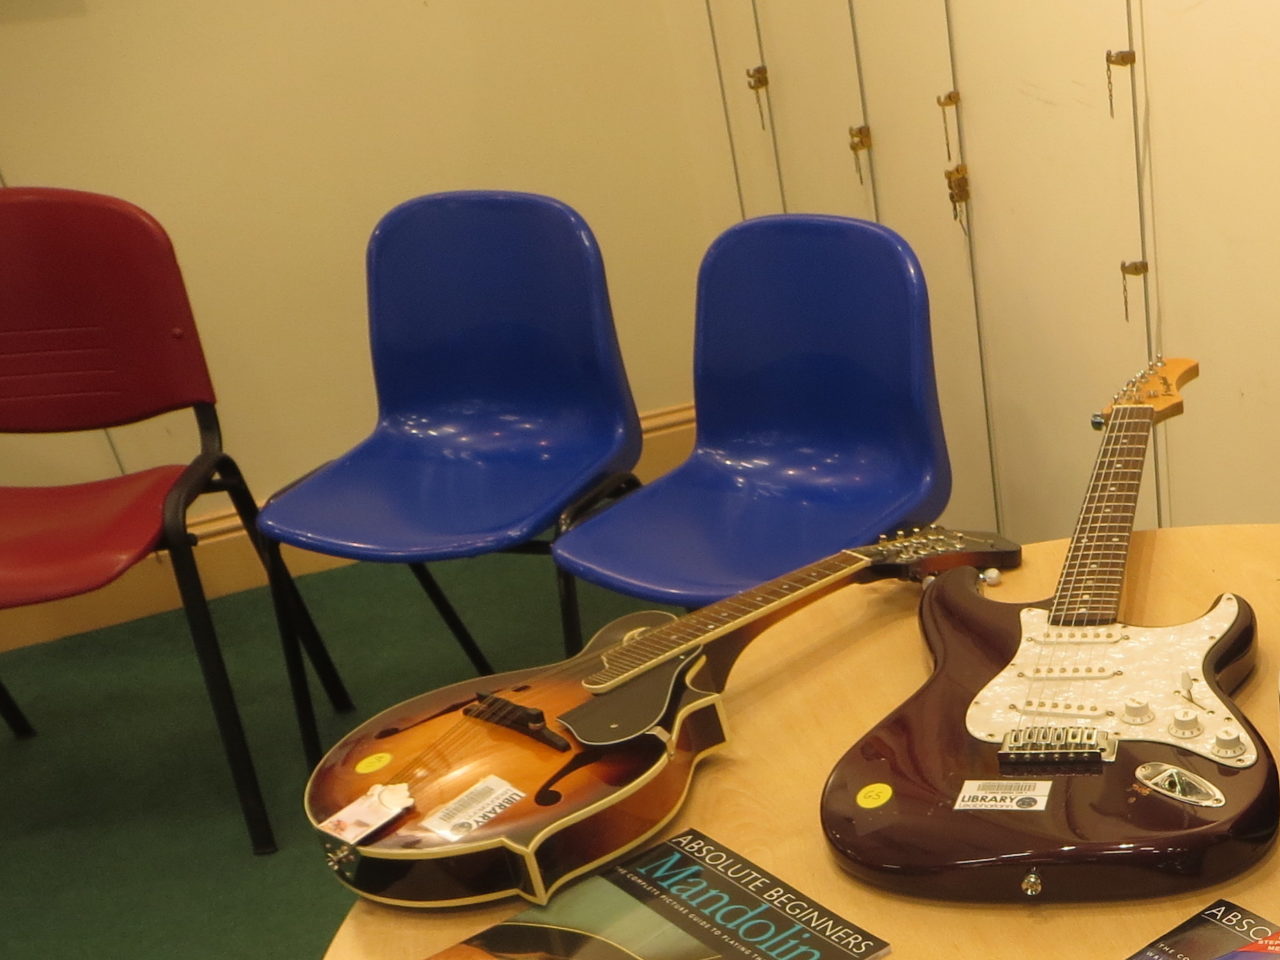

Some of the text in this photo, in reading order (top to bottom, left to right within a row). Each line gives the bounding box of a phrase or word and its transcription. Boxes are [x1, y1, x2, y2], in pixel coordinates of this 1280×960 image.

[474, 792, 523, 826] LIBRARY
[626, 872, 660, 897] COMPLETE
[660, 894, 688, 914] PICTURE
[689, 910, 711, 929] GUIDE
[711, 926, 721, 936] TO
[722, 932, 750, 955] PLAYING
[672, 835, 874, 954] ABSOLUTE BEGINNERS
[1159, 943, 1175, 954] THE
